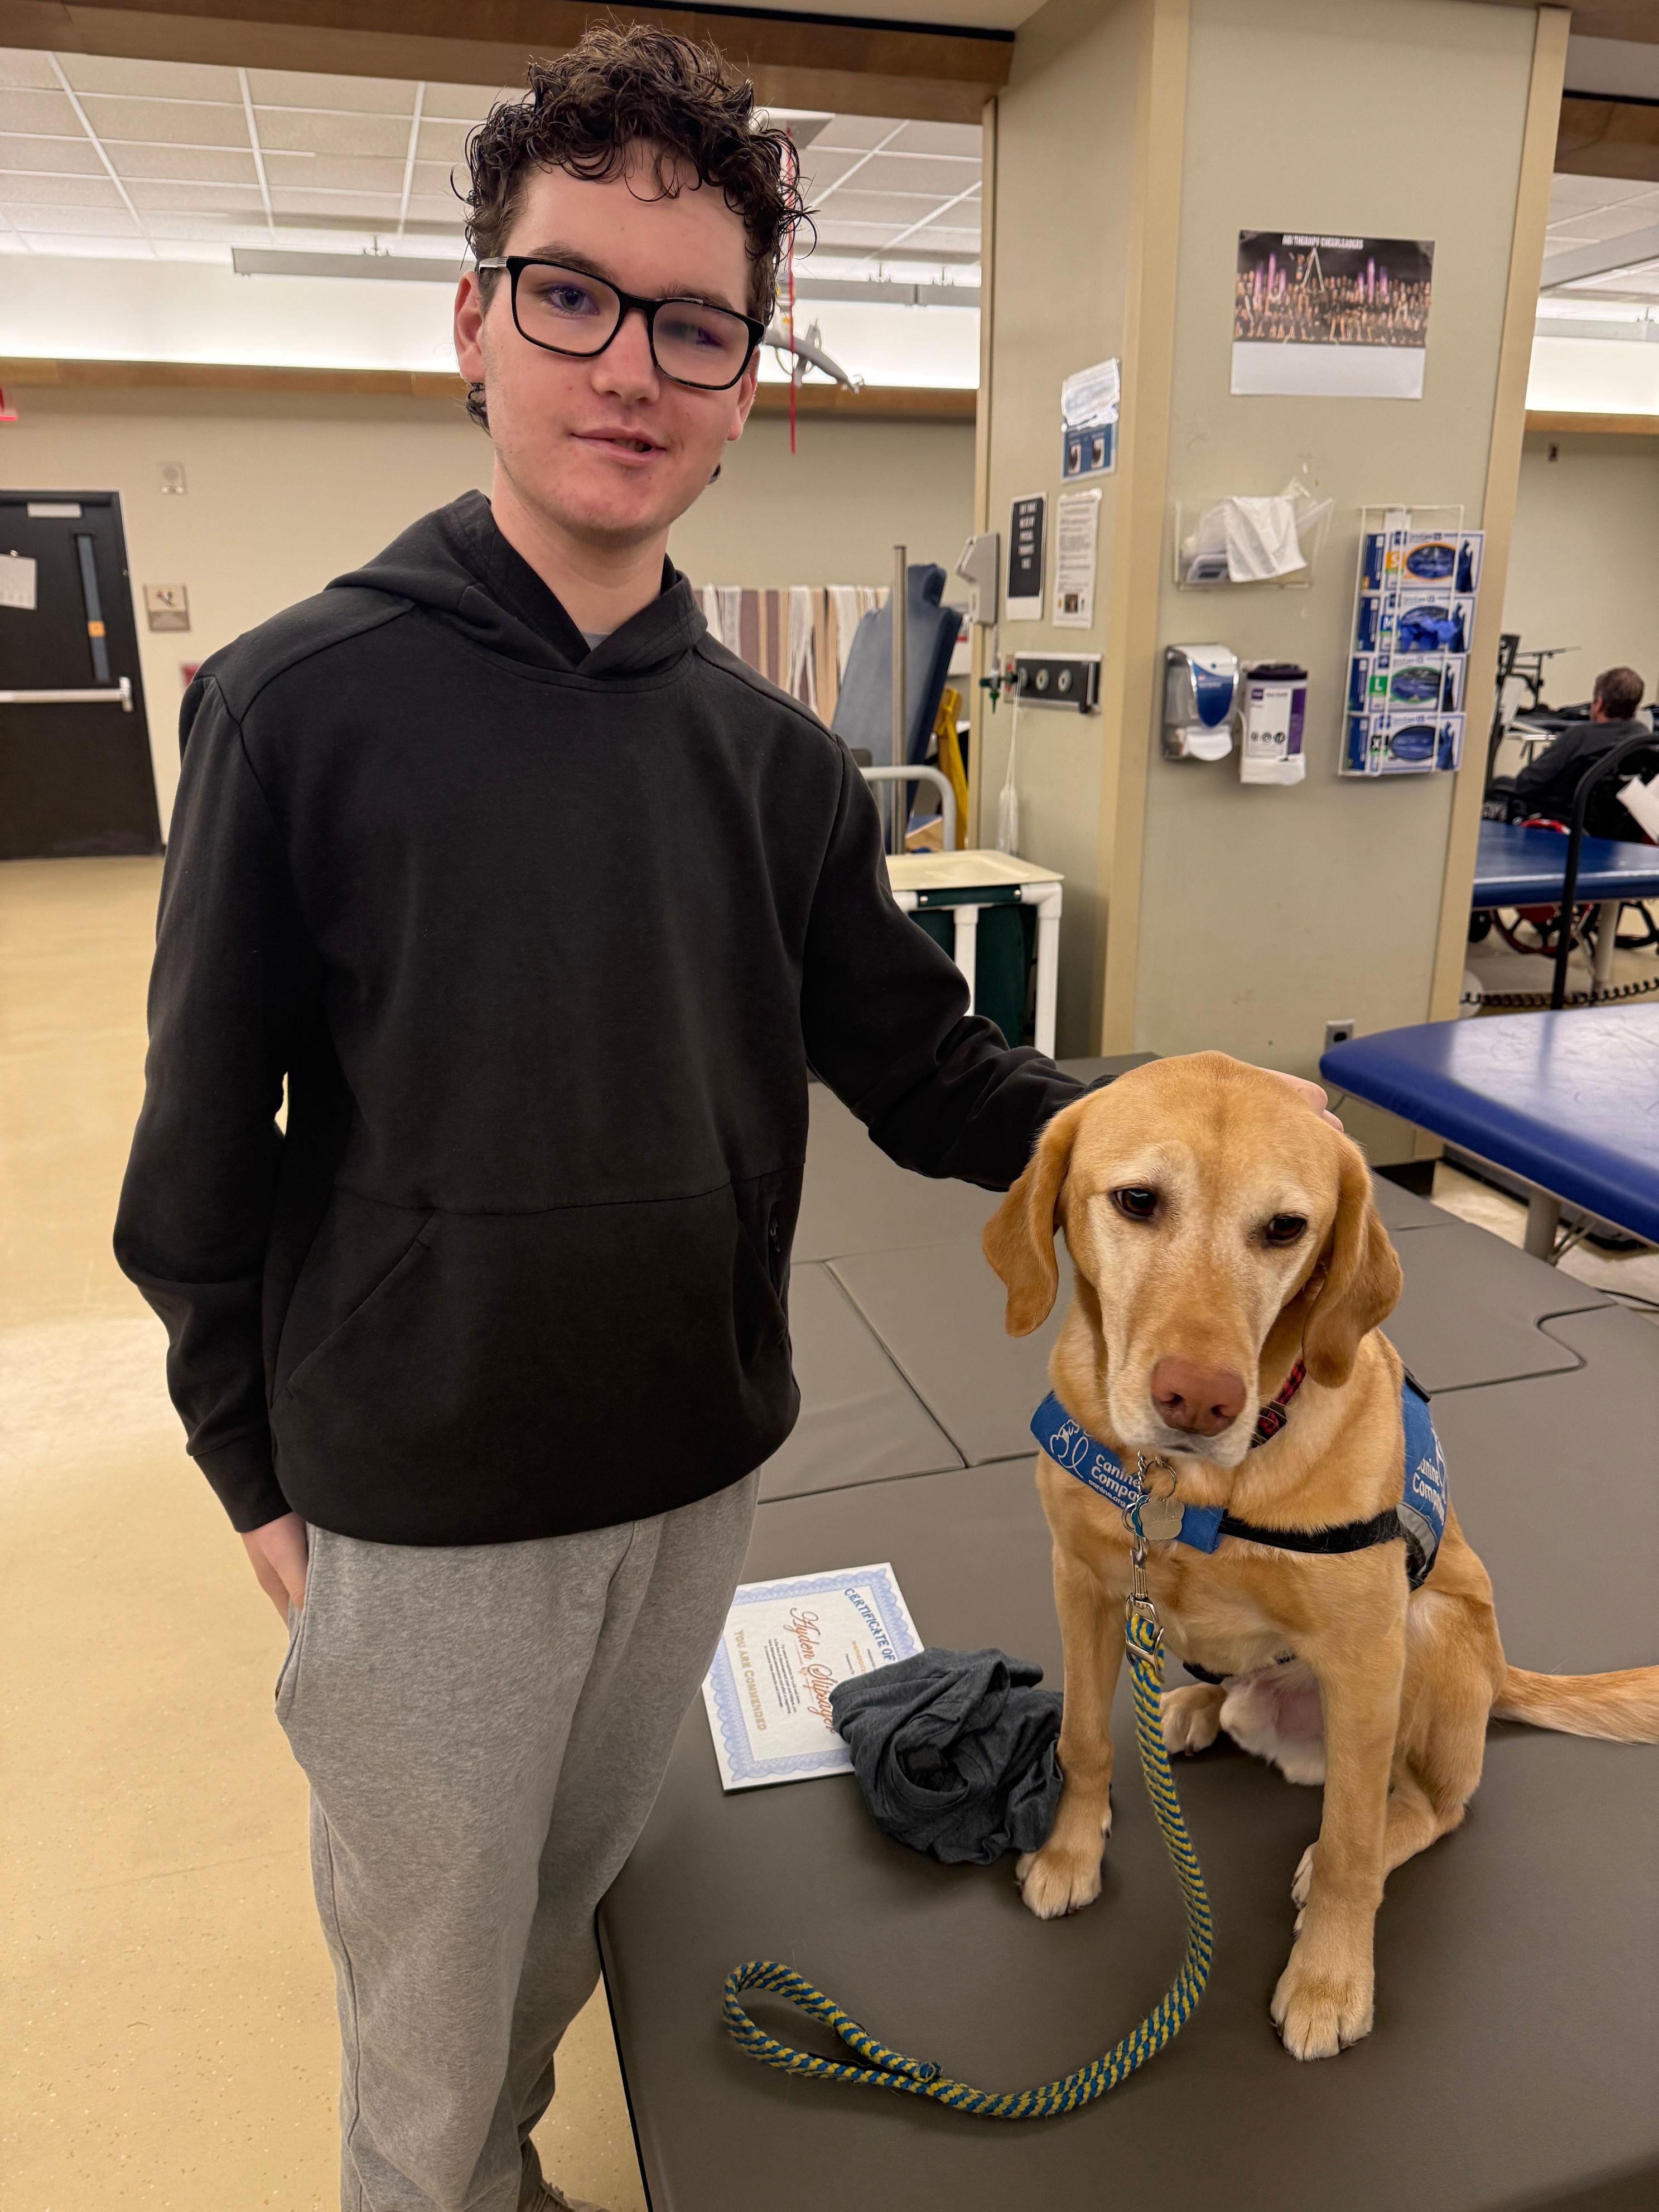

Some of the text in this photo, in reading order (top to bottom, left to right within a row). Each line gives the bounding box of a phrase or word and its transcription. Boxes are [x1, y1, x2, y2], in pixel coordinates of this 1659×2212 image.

[1391, 554, 1398, 568] S
[1374, 678, 1382, 690] L
[1091, 1466, 1137, 1501] Compa
[1096, 1453, 1139, 1488] Canine
[1088, 1479, 1126, 1508] canine.org
[783, 1608, 820, 1663] Ayden
[844, 1588, 895, 1662] CERTIFICATE OF
[734, 1630, 766, 1731] YOU ARE COMMENDED
